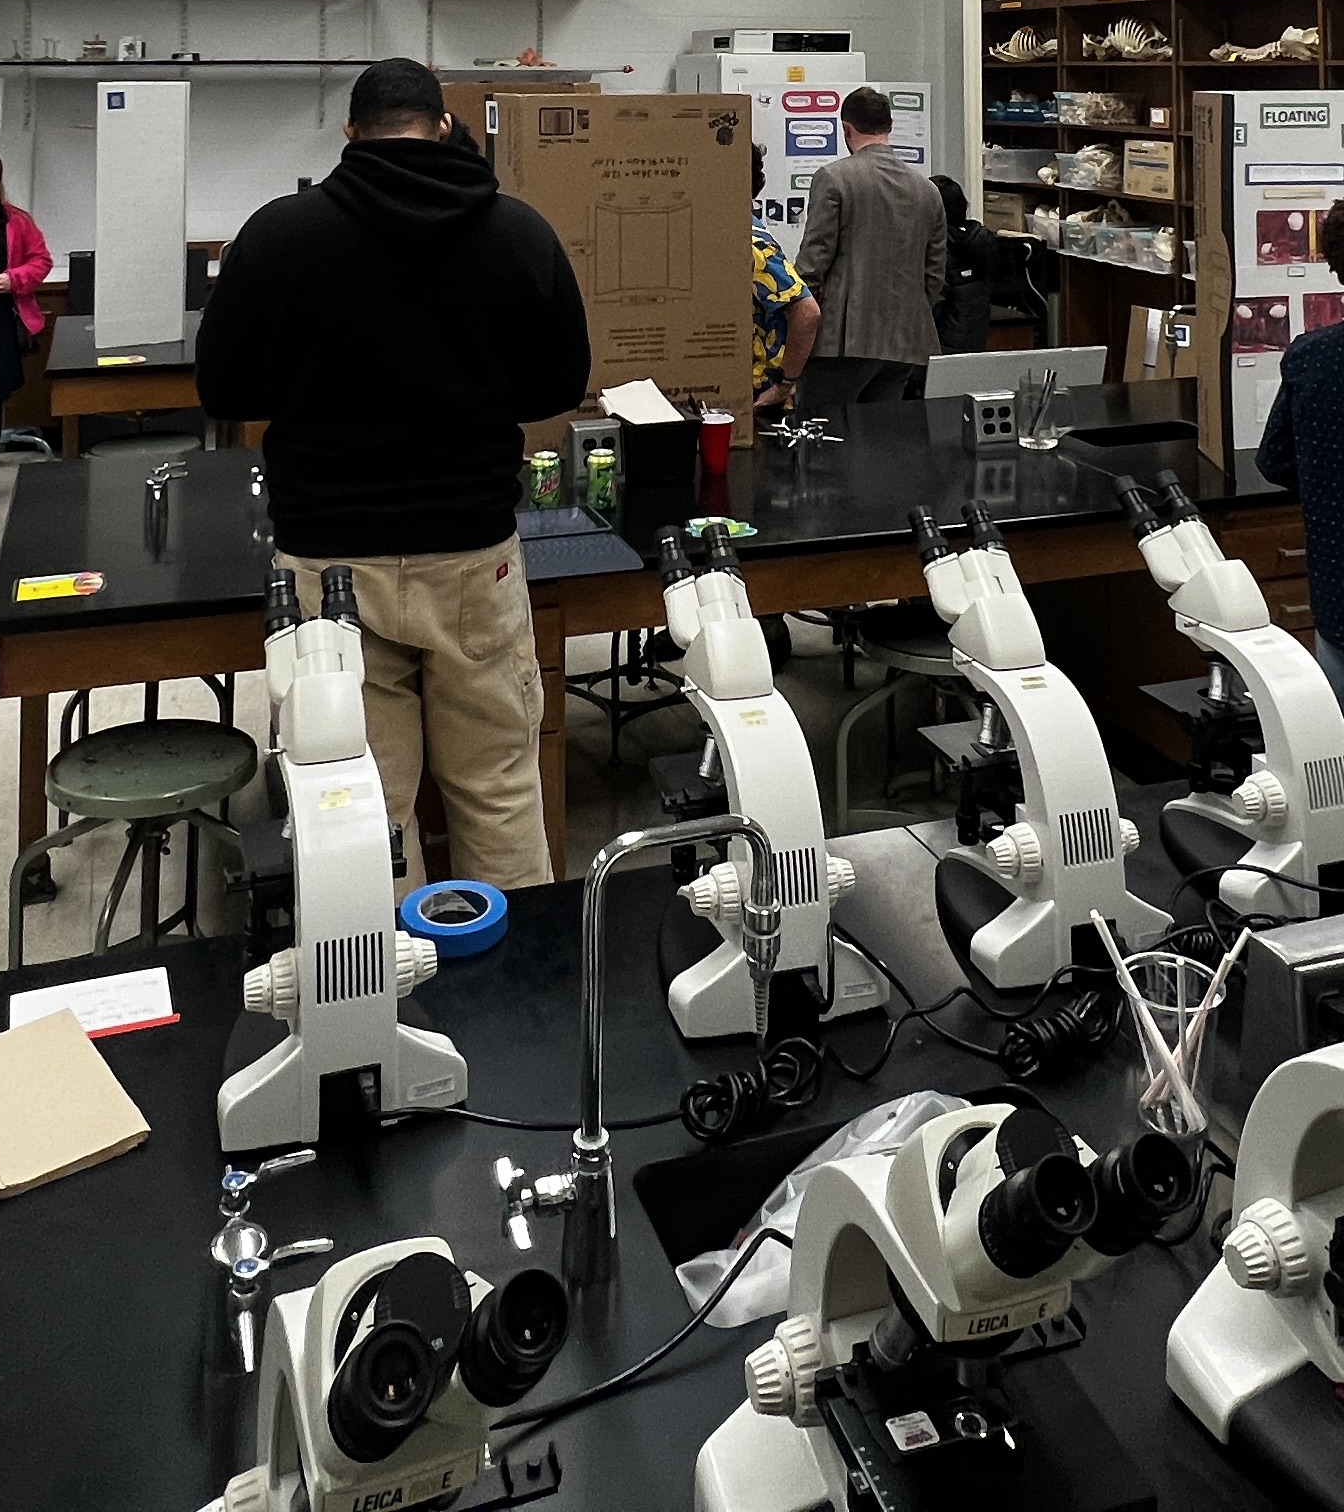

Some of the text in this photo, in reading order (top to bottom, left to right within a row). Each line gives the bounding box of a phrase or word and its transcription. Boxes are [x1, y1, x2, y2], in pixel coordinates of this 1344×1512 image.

[1264, 109, 1327, 124] FLOATING
[967, 1314, 1009, 1335] LEICA
[352, 1487, 403, 1512] LEICA
